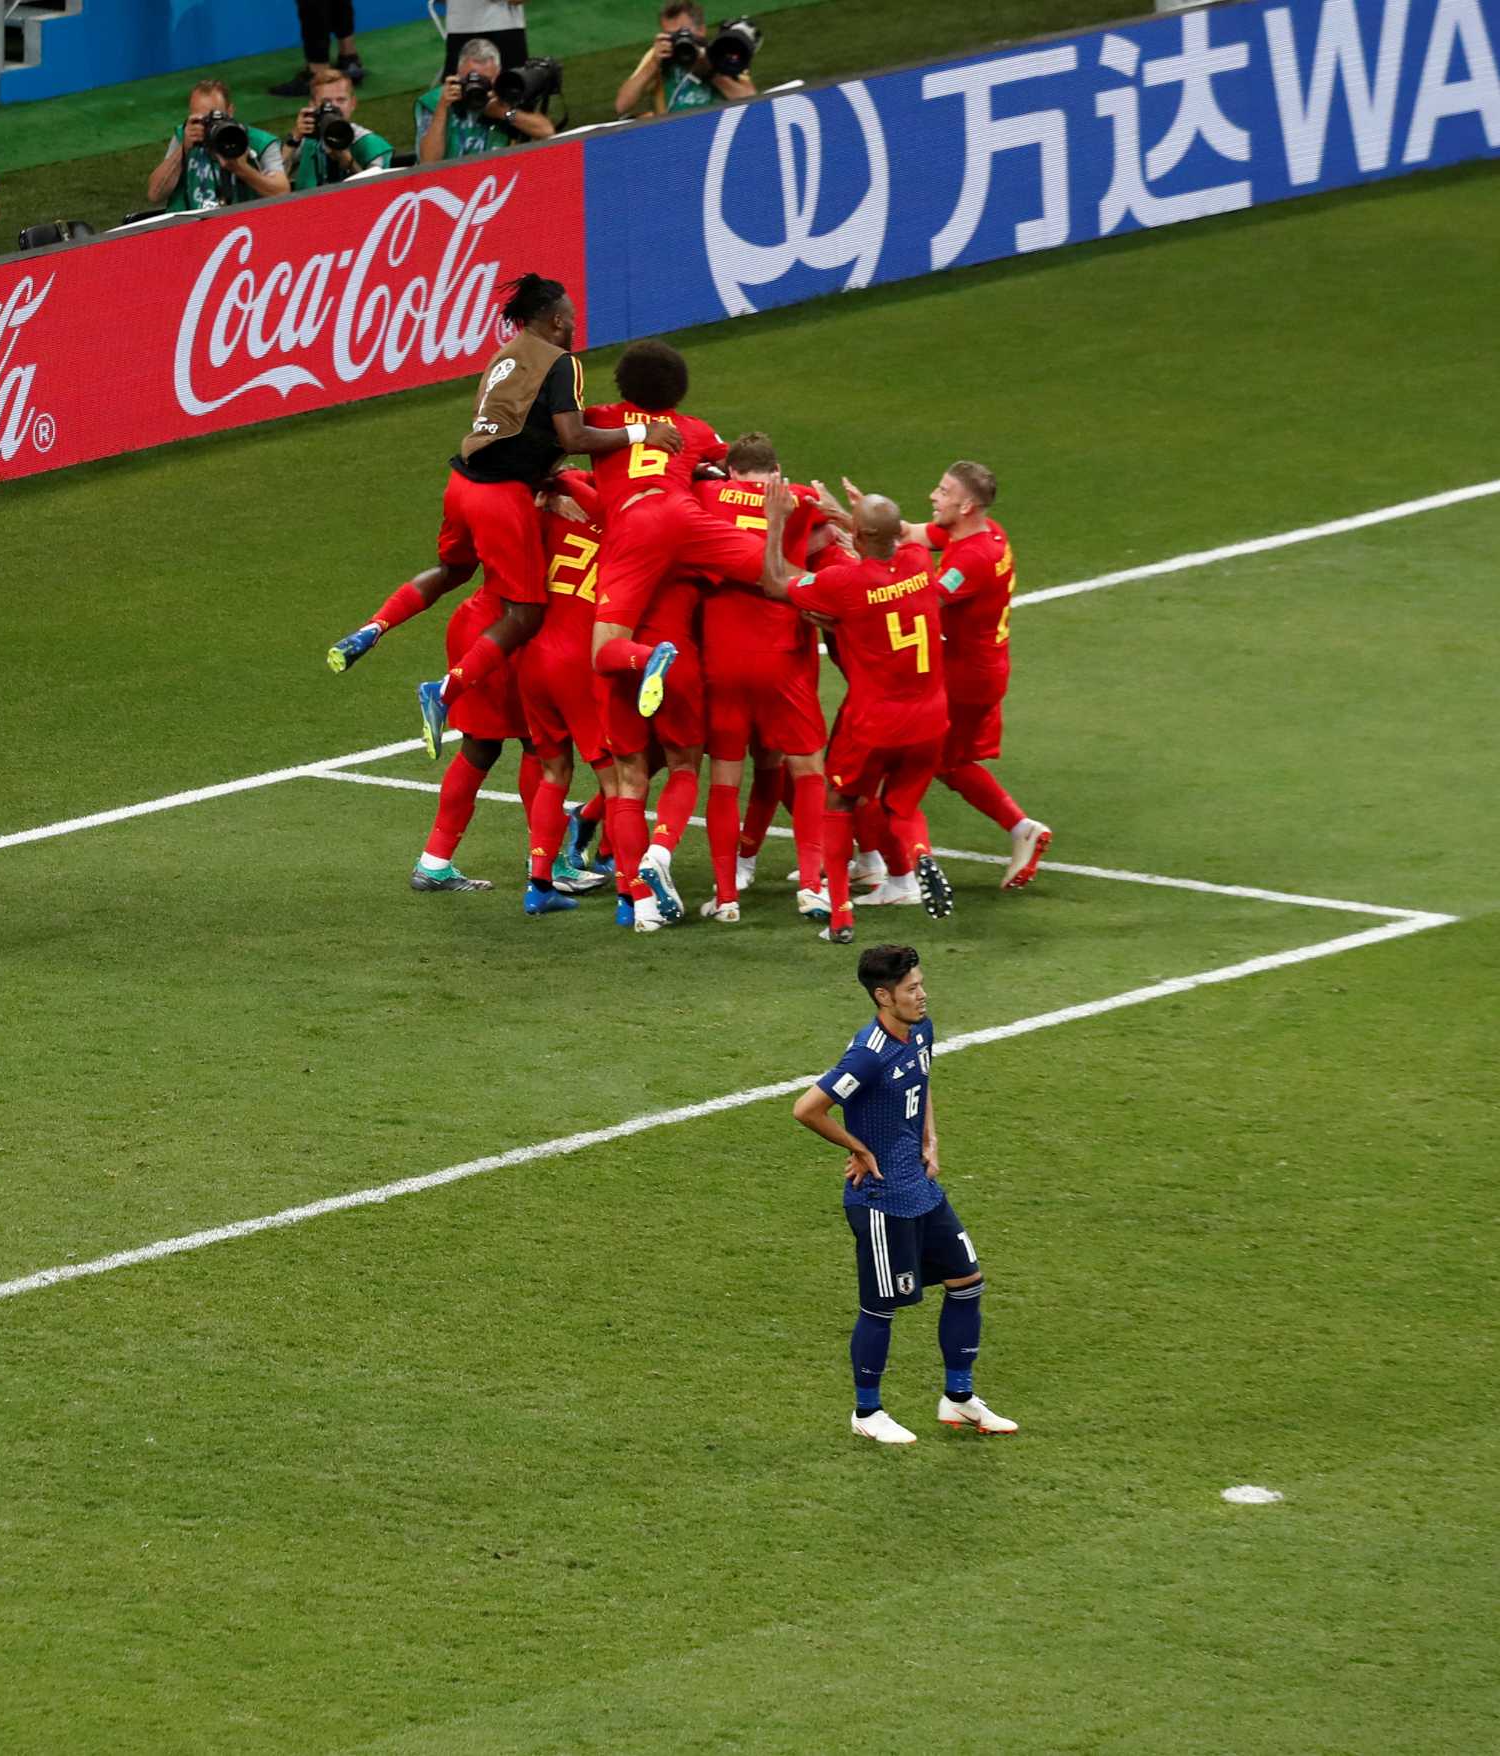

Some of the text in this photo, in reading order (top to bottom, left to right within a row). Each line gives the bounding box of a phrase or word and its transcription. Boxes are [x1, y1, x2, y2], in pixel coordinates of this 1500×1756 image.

[922, 10, 1252, 271] 万达
[174, 172, 519, 416] Coca-Cola
[866, 571, 930, 605] KOMPANY
[885, 611, 930, 673] 4
[905, 1084, 922, 1120] 16
